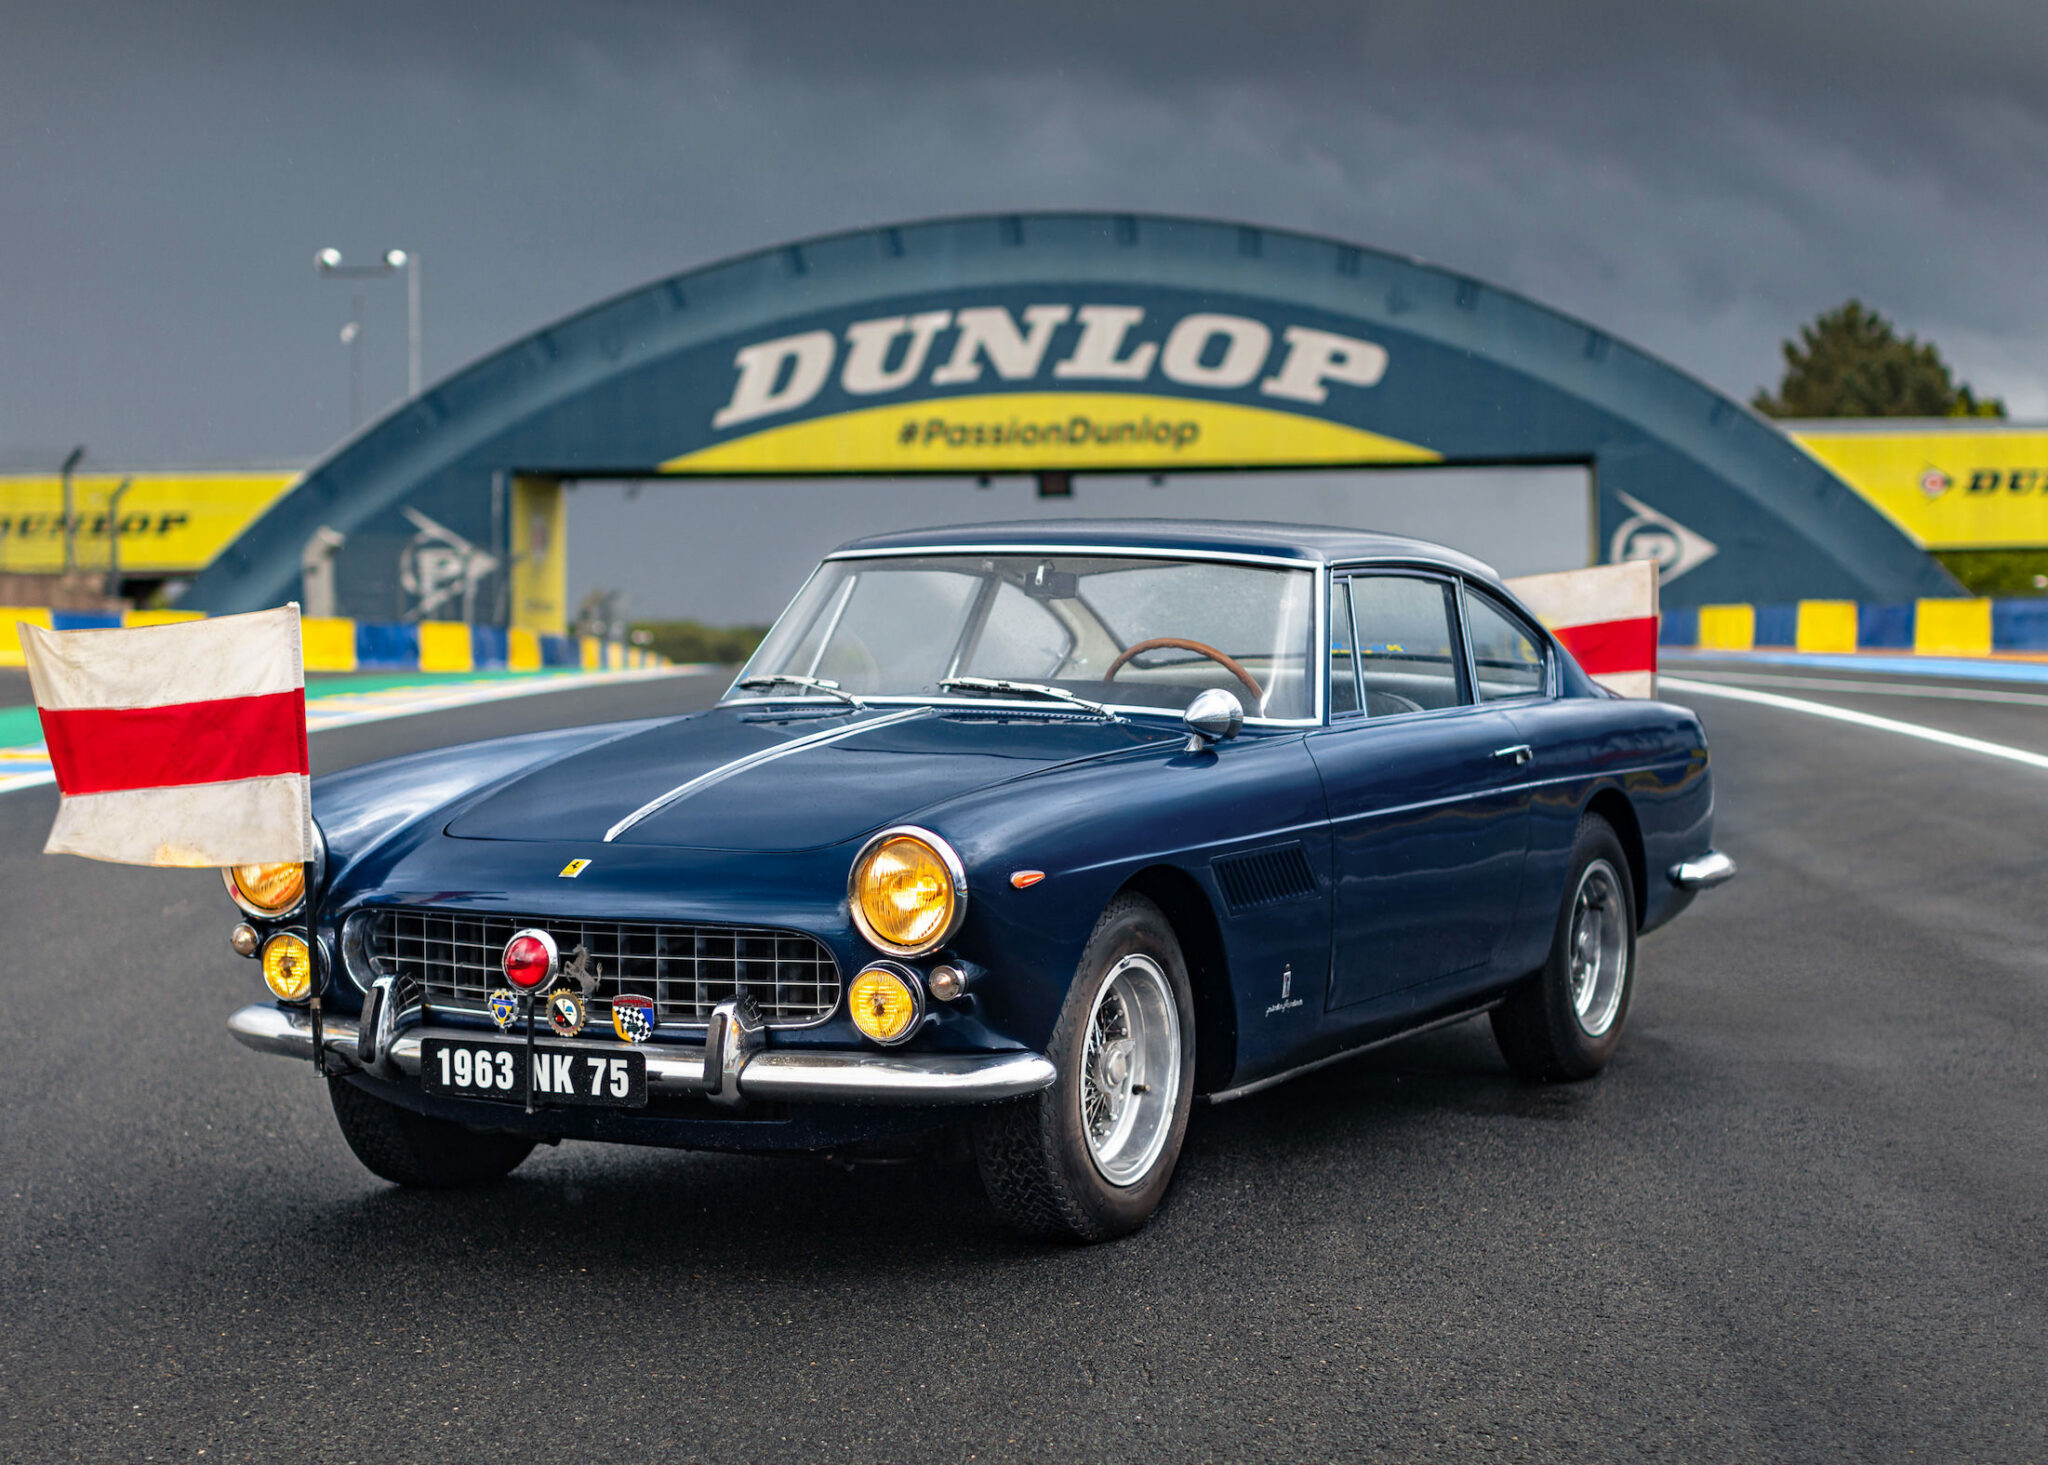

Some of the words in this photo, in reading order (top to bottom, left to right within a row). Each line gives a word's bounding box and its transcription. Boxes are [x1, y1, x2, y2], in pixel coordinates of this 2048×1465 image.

[712, 305, 1388, 429] DUNLOP
[898, 416, 1199, 451] #PassionDunlop
[1966, 467, 2048, 496] DU
[437, 1048, 514, 1090] 1963
[533, 1053, 575, 1094] NK
[587, 1057, 629, 1098] 75
